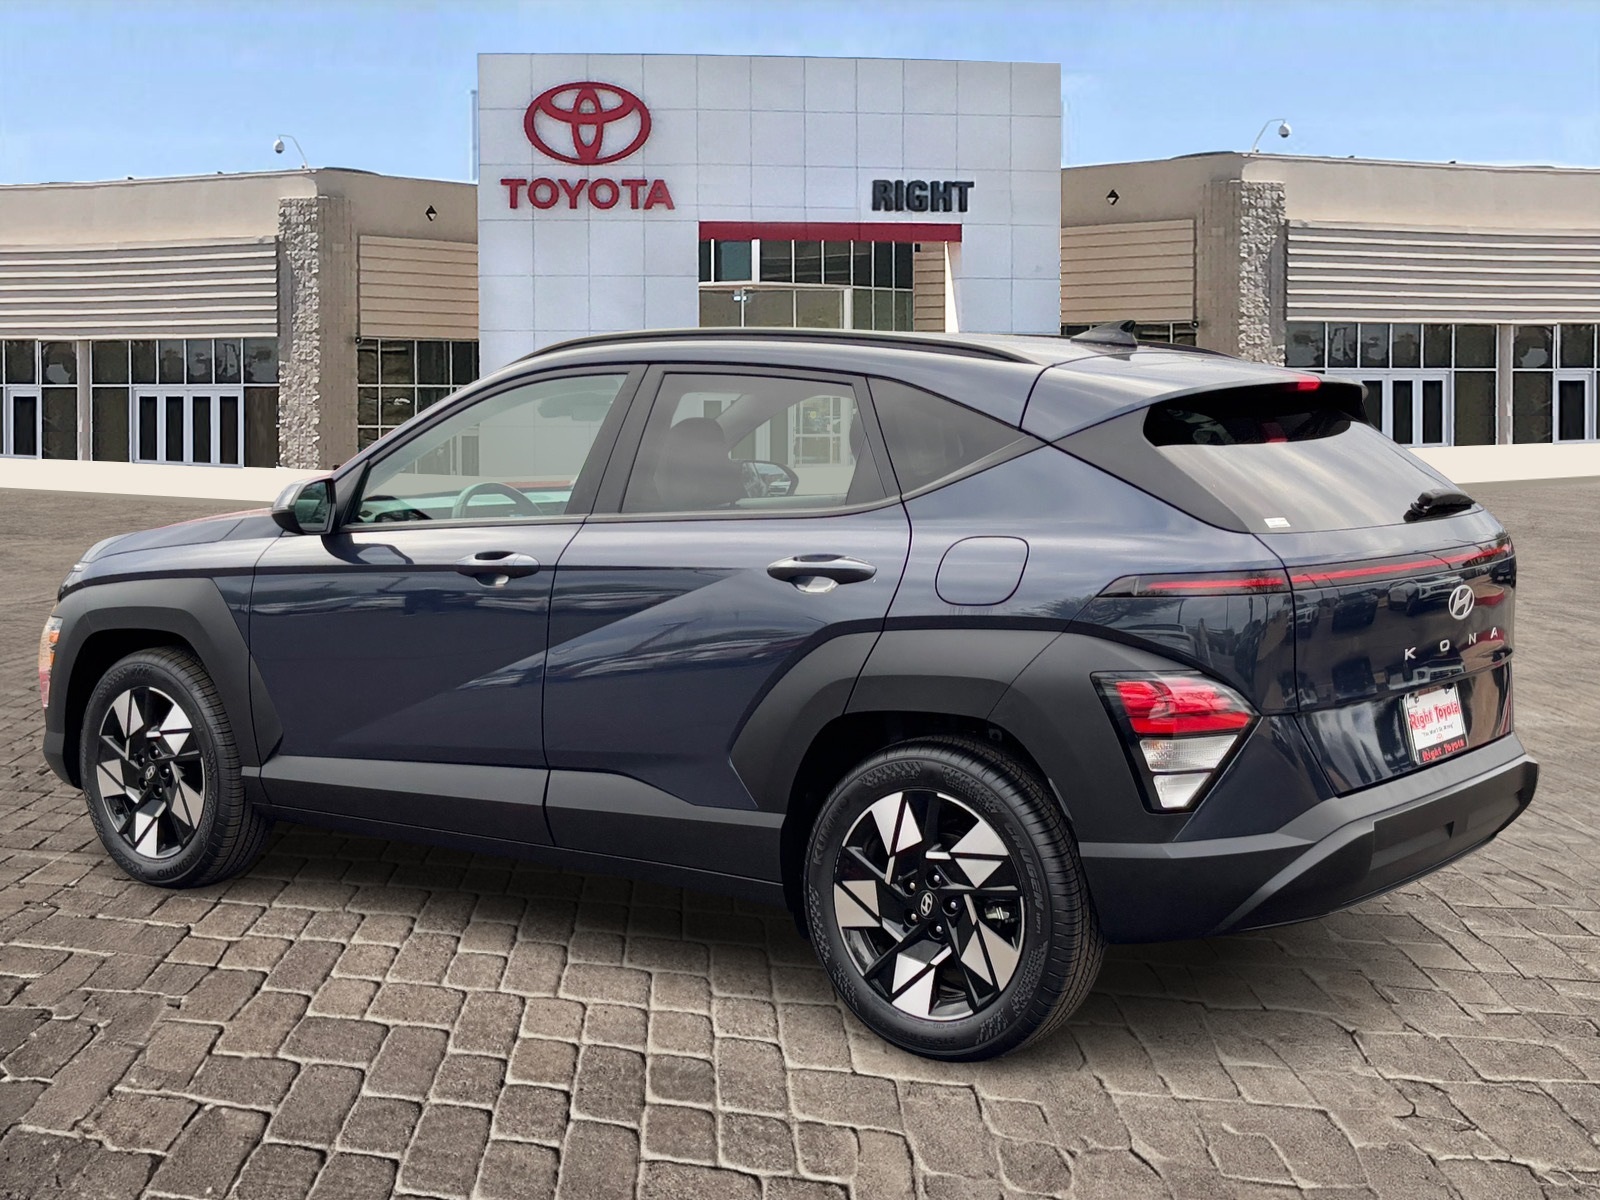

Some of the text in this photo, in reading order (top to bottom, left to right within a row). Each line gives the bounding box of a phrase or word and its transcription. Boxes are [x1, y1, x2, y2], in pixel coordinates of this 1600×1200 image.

[500, 178, 675, 209] TOYOTA
[872, 180, 974, 212] RIGHT
[1404, 626, 1498, 660] KONA
[1409, 709, 1433, 729] Right
[1434, 703, 1460, 723] Toyota
[1444, 739, 1464, 753] Toyota
[1004, 822, 1044, 911] CRUGEN
